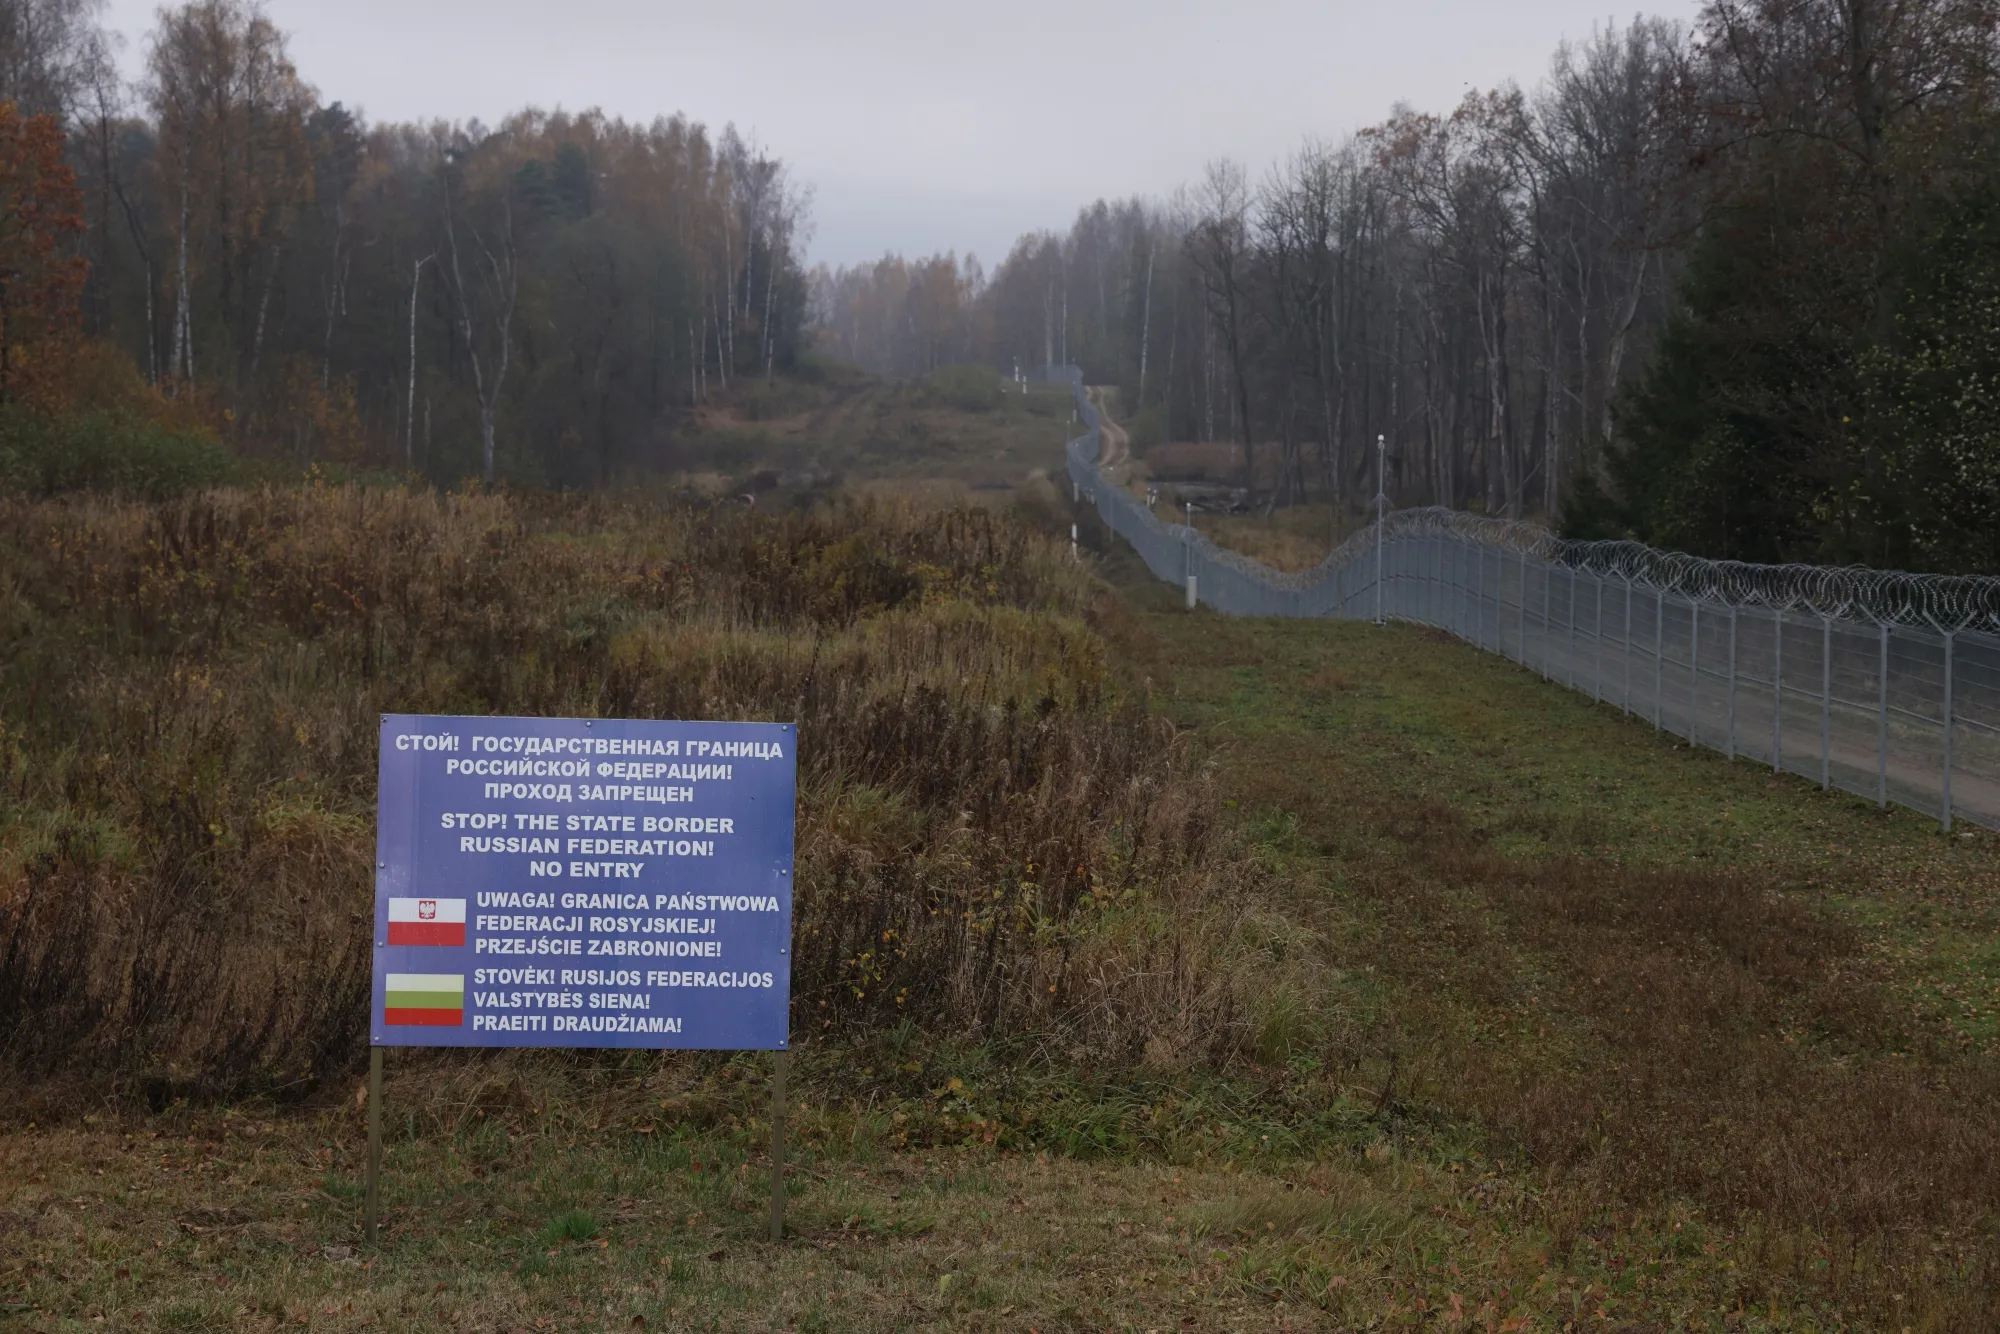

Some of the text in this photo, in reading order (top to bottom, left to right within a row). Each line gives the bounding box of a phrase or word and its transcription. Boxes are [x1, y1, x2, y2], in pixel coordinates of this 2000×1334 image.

[396, 732, 783, 760] СТОЙ! ГОСУДАРСТВЕННАЯ ГРАНИЦА
[447, 757, 732, 782] РОССИЙСКОЙ ФЕДЕРАЦИИ!
[485, 783, 693, 804] ПРОХОД ЗАПРЕЩЕН
[441, 813, 734, 833] STOP! THE STATE BORDER
[461, 837, 713, 856] RUSSIAN FEDERATION!
[531, 861, 644, 878] NO ENTRY
[477, 892, 779, 911] UWAGA! GRANICA PAŃSTWOWA
[477, 915, 715, 933] FEDERACJI ROSYJSKIEJ!
[476, 936, 721, 957] PRZEJŚCIE ZABRONIONE!
[474, 966, 773, 987] STOVĖK! RUSIJOS FEDERACIJOS
[589, 993, 650, 1009] SIENA!
[473, 1013, 681, 1032] PRAEITI DRAUDŽIAMA!
